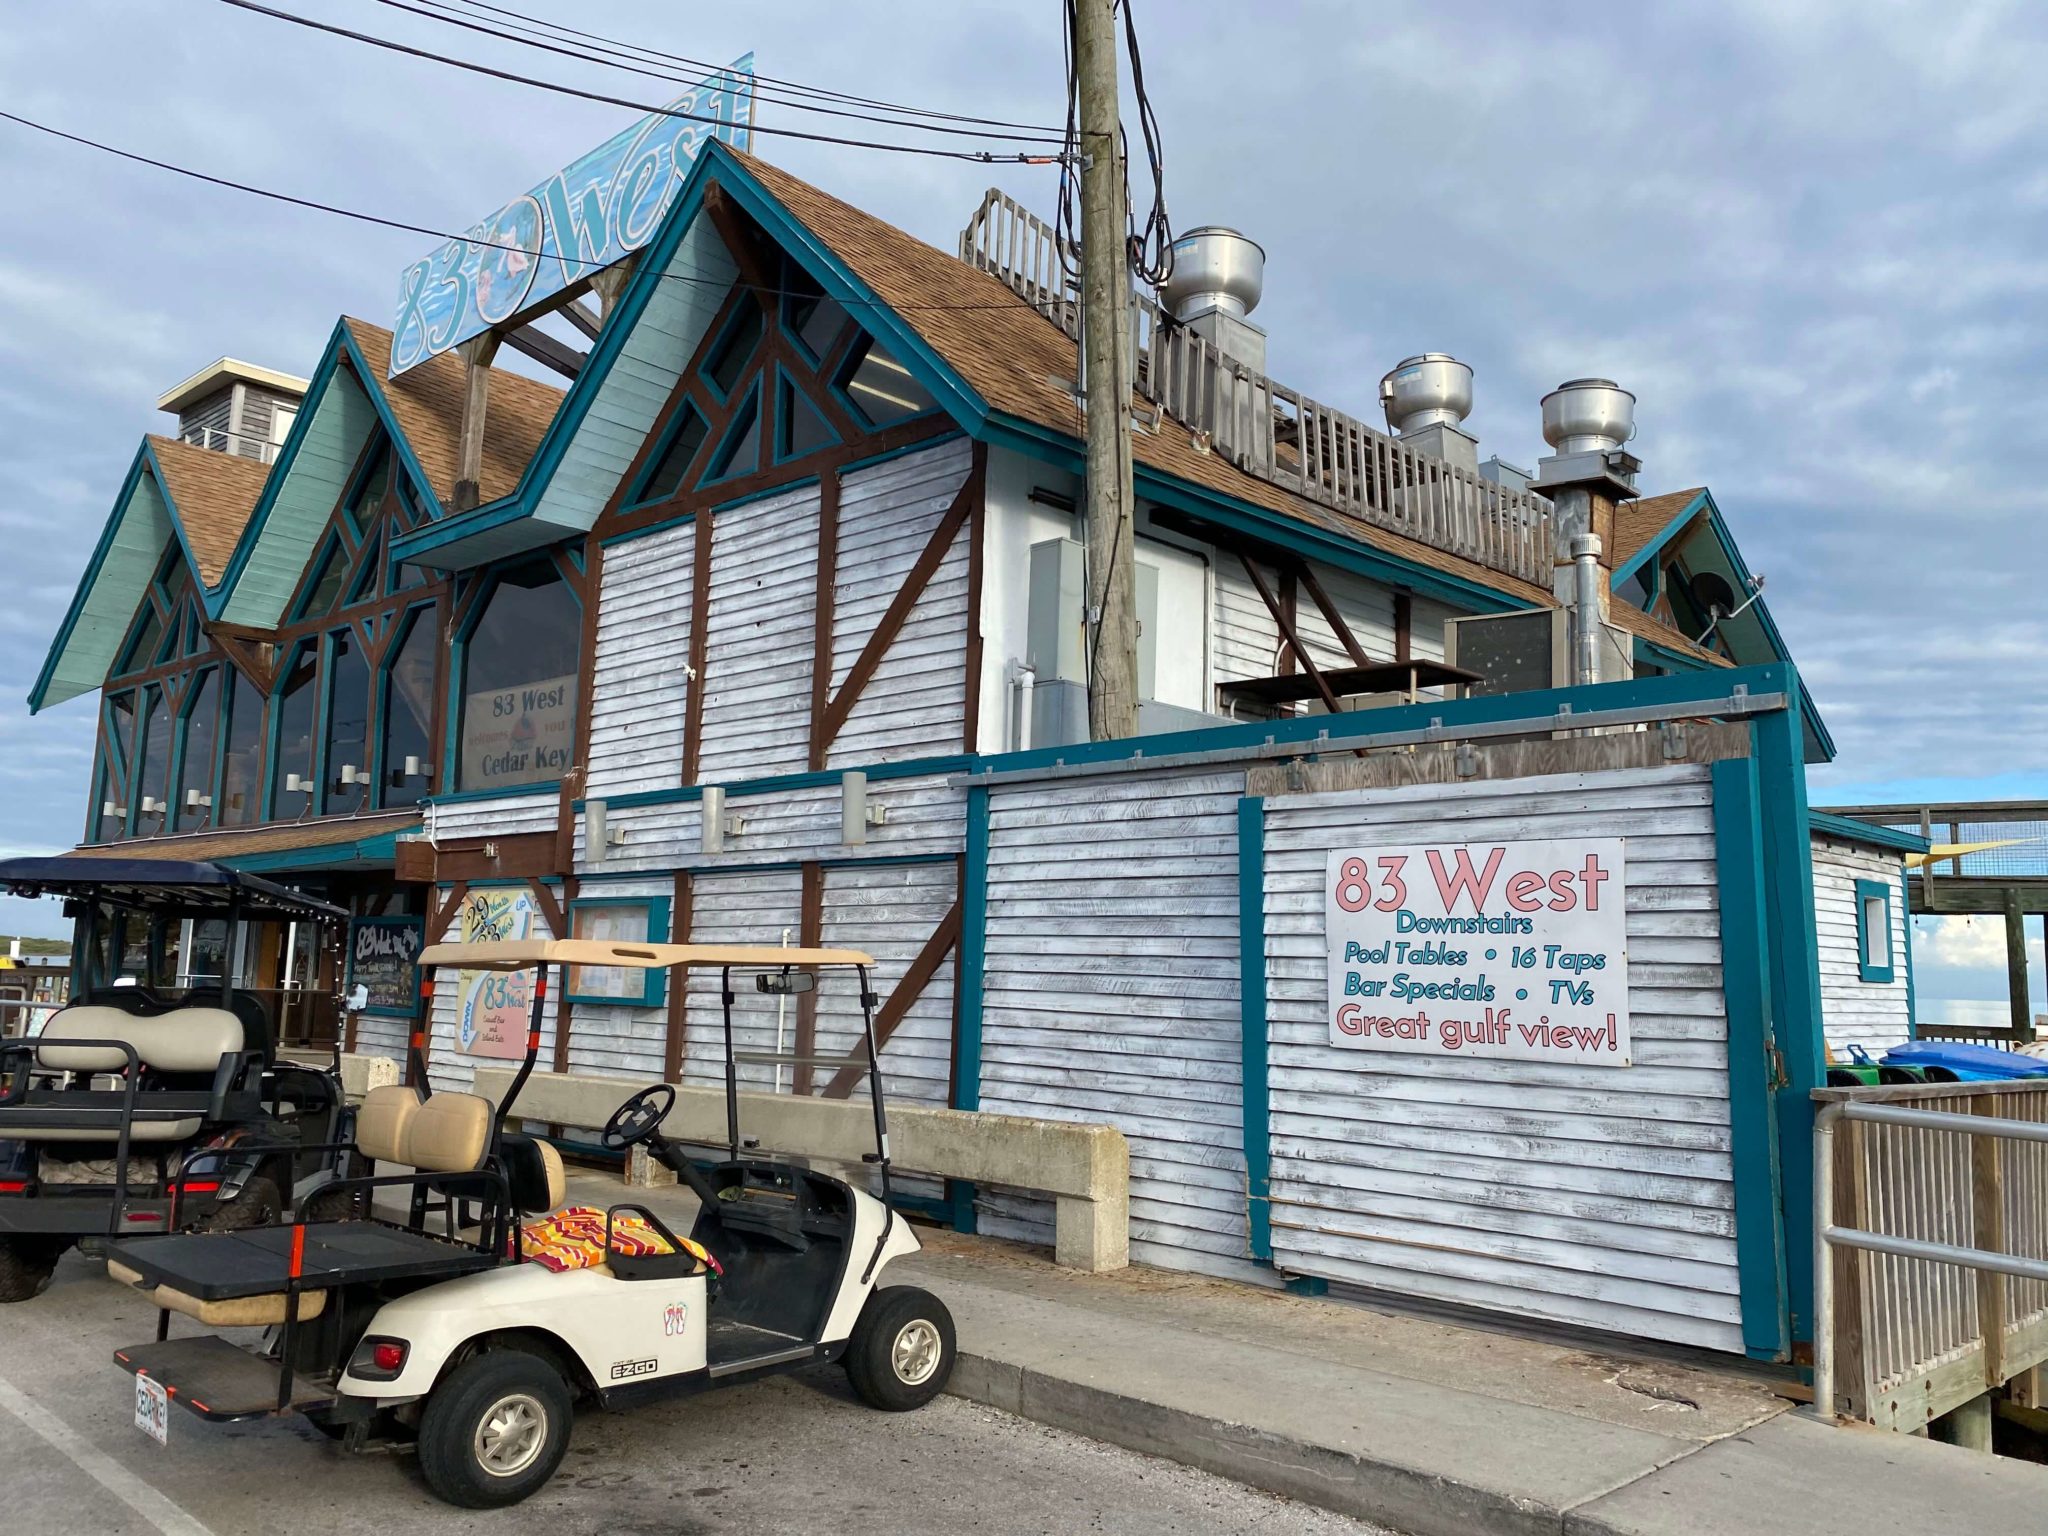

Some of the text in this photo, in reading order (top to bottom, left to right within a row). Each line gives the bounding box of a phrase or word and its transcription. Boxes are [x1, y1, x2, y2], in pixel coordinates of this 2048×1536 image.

[493, 684, 565, 718] 83 West
[481, 745, 570, 776] Cedar Key
[1336, 848, 1609, 914] 83 West
[515, 899, 527, 911] UP
[1397, 910, 1533, 934] Downstairs
[1345, 941, 1606, 975] Pool Tables 16 Taps
[506, 991, 525, 1008] West
[1344, 972, 1594, 1005] Bar Specials TVs
[463, 1001, 472, 1042] DOWN
[1337, 1003, 1617, 1051] Great gulf view!
